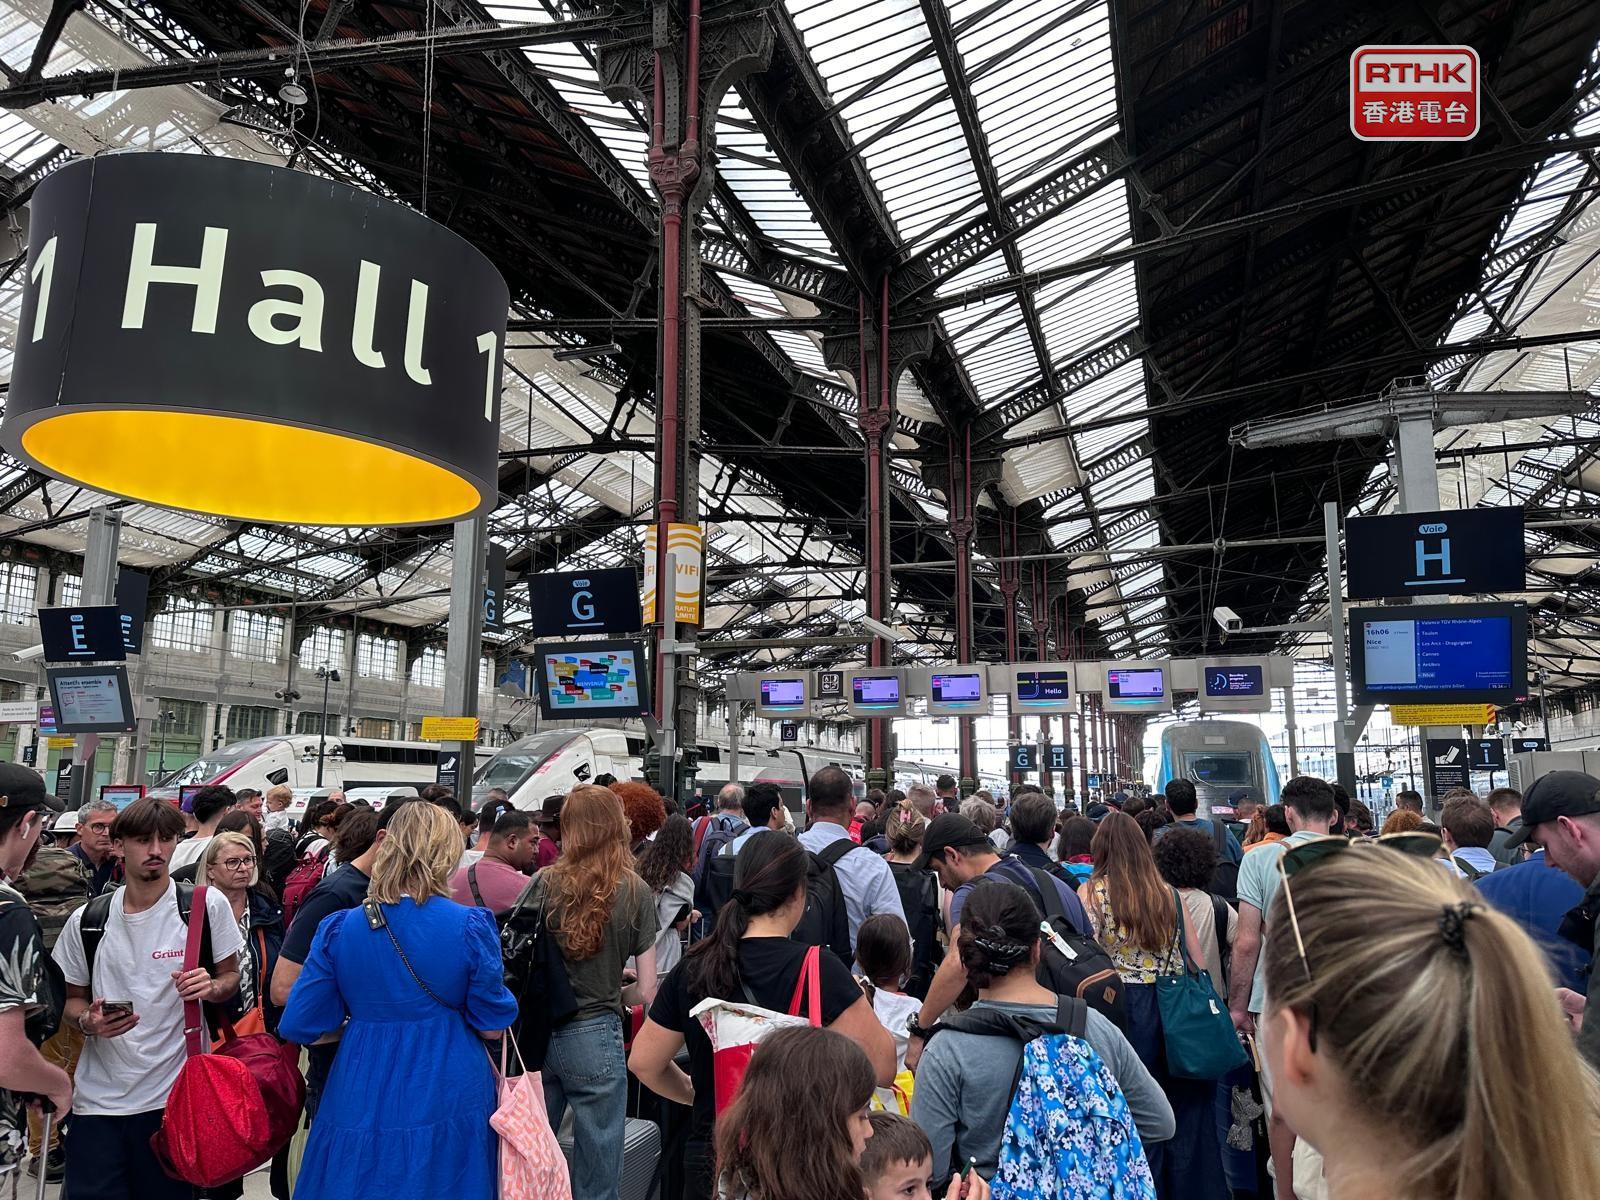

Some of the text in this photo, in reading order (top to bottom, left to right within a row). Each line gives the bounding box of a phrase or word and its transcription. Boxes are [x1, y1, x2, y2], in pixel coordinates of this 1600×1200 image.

[31, 222, 497, 422] 1 Hall 1
[1422, 525, 1443, 533] Voie
[1415, 538, 1450, 576] H
[485, 598, 496, 621] G
[571, 590, 595, 620] G
[71, 625, 88, 649] E
[1017, 753, 1028, 766] G
[1053, 754, 1064, 766] H
[152, 949, 184, 960] Grünt
